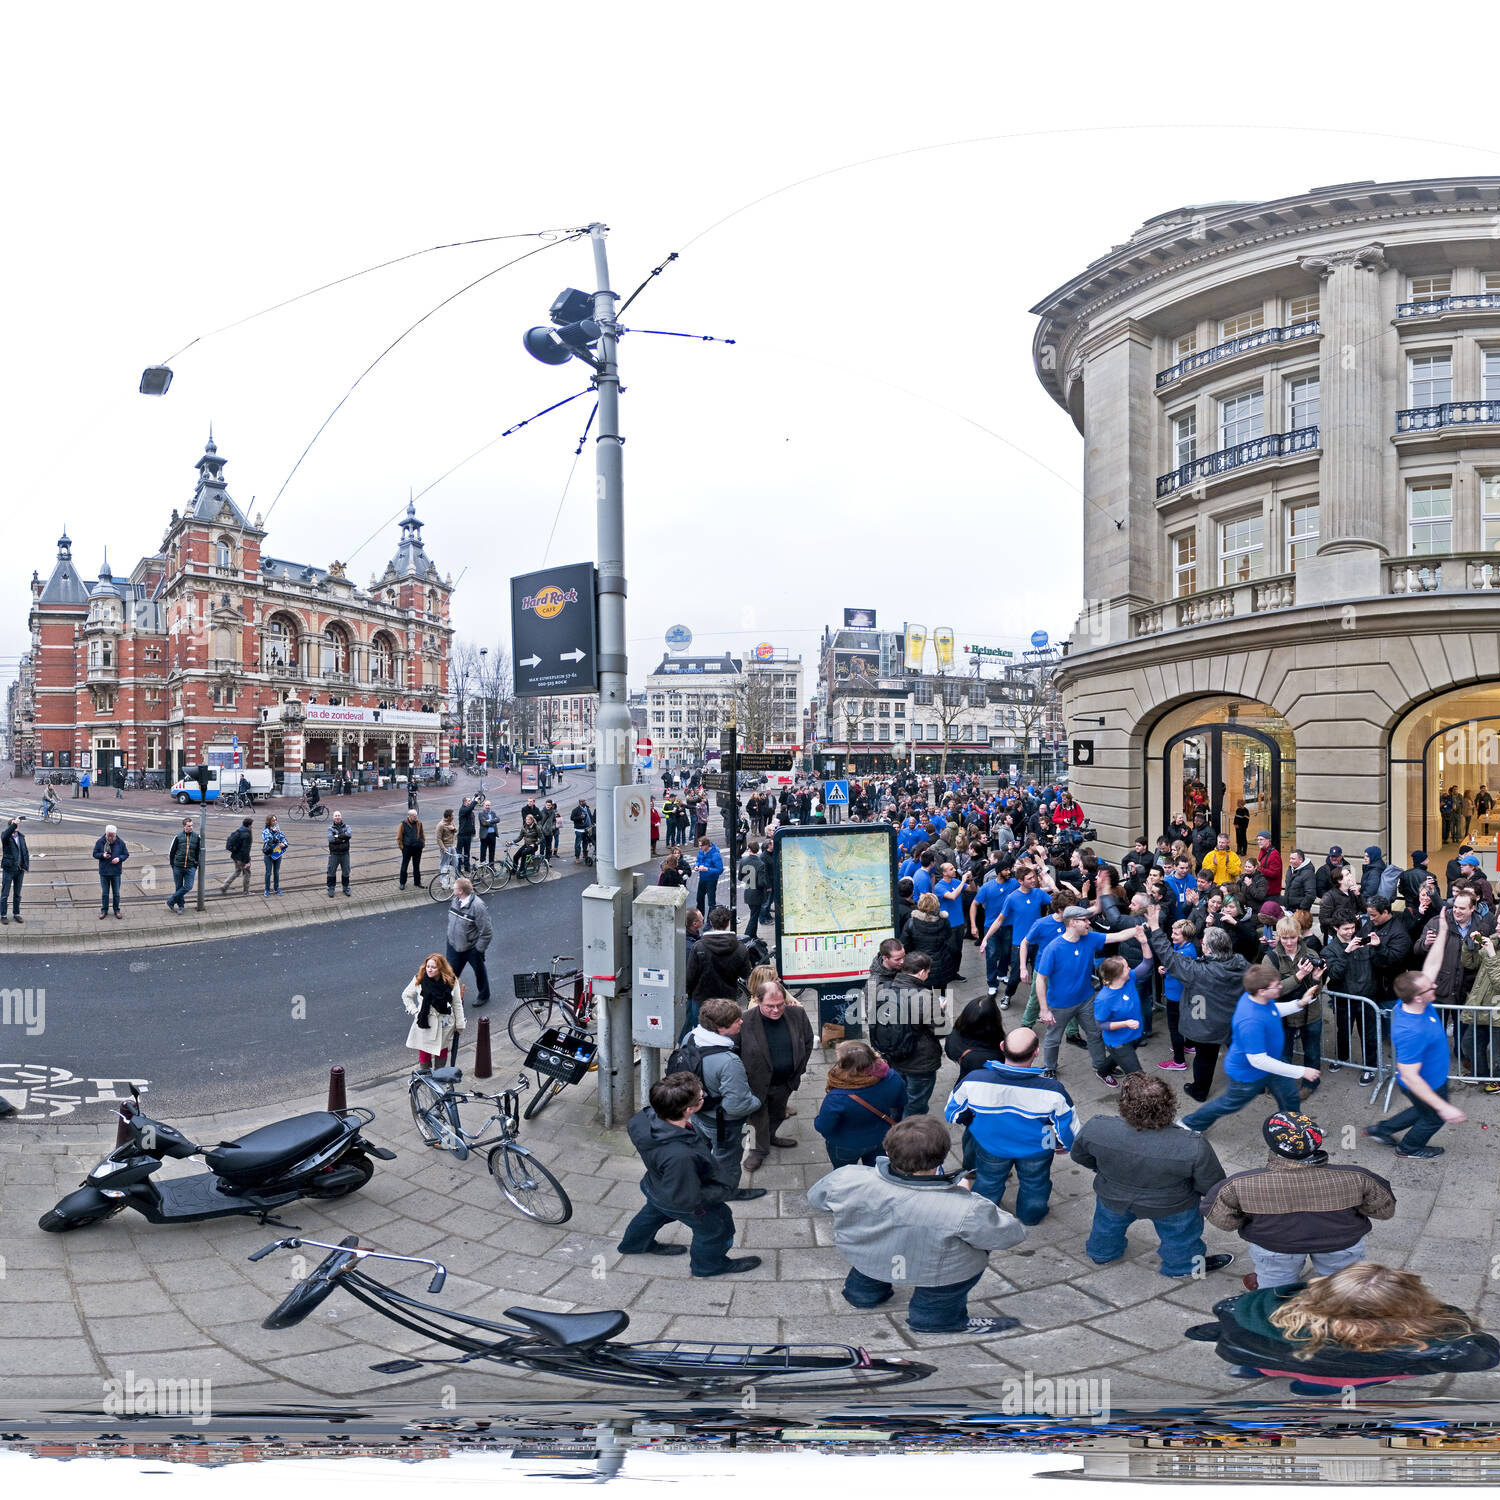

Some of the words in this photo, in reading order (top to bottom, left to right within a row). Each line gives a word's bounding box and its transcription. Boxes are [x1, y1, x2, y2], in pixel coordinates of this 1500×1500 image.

[521, 593, 550, 610] Hard
[549, 588, 578, 605] Rock
[541, 606, 556, 614] CAFE
[971, 645, 1013, 657] Heineken
[308, 711, 318, 719] na
[319, 710, 330, 719] de
[331, 711, 364, 721] zondeval
[820, 992, 859, 1001] JCDecaux
